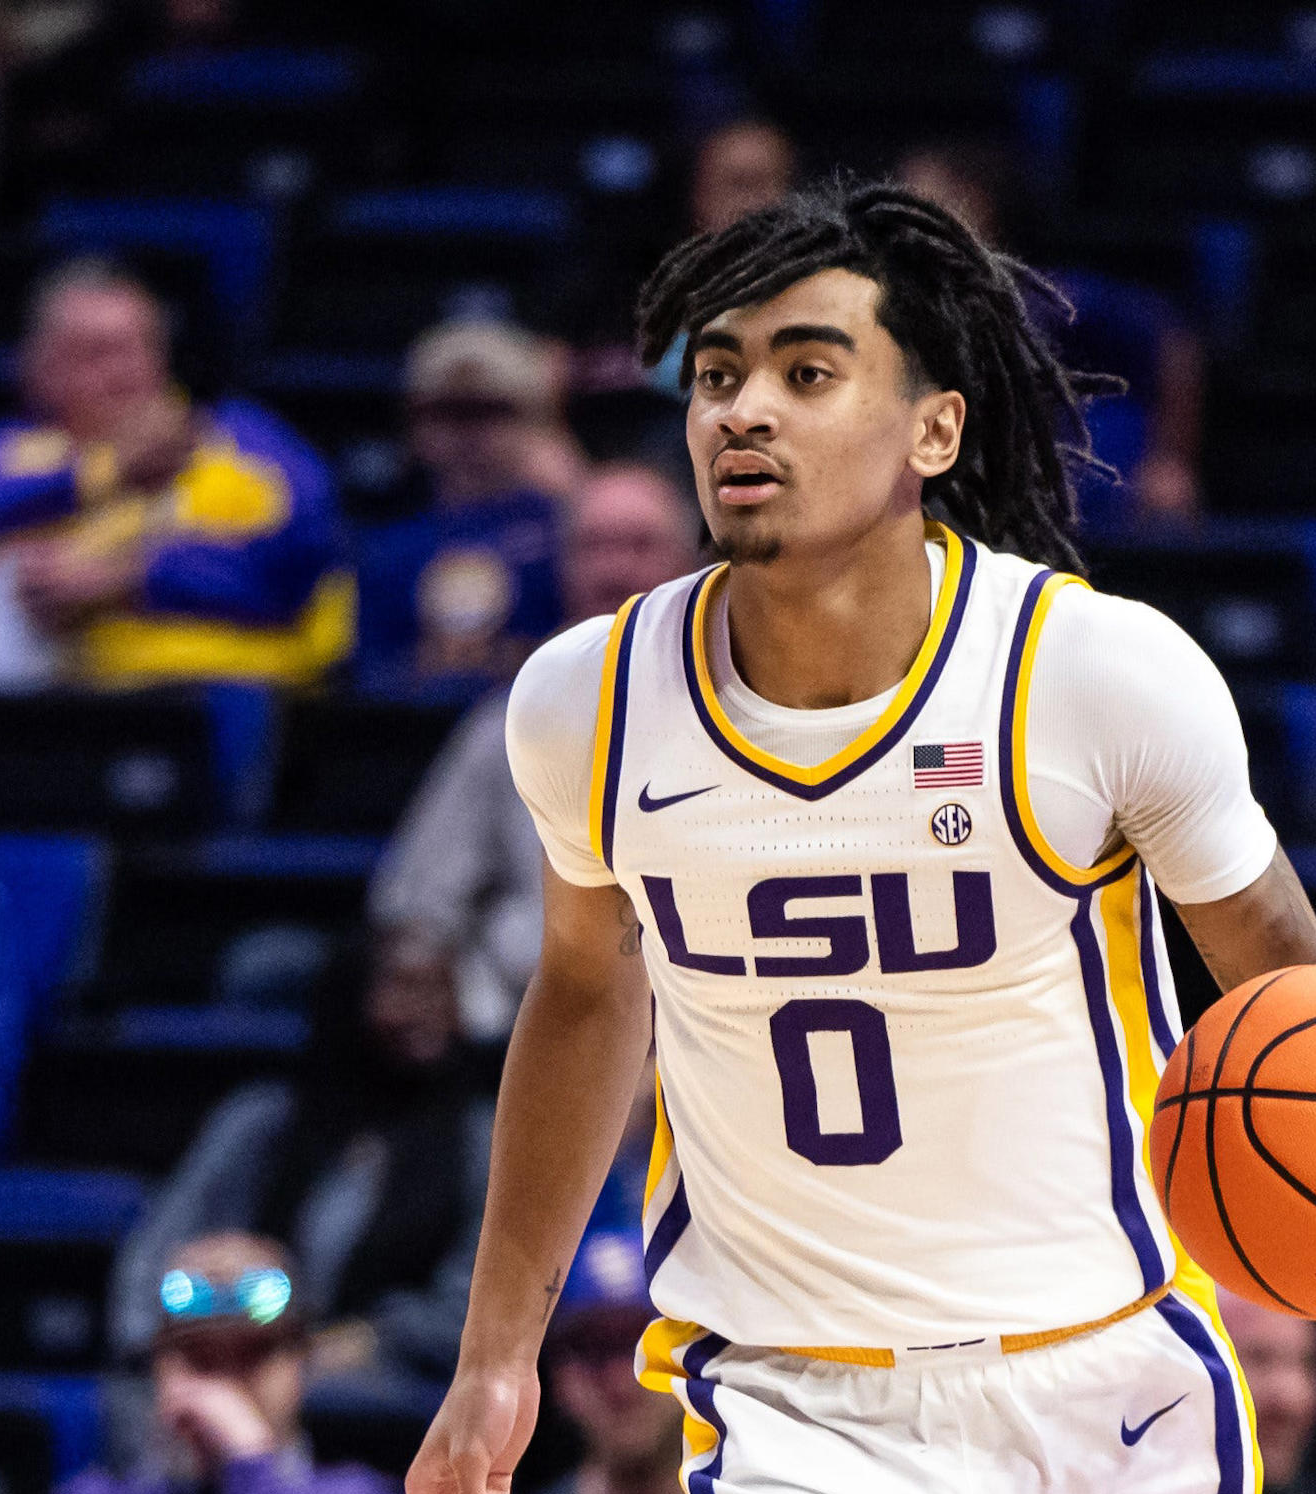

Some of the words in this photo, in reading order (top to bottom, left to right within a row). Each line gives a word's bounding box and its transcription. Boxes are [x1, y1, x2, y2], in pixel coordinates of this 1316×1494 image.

[933, 804, 971, 844] SEC
[641, 871, 997, 978] LSU
[770, 999, 903, 1166] 0
